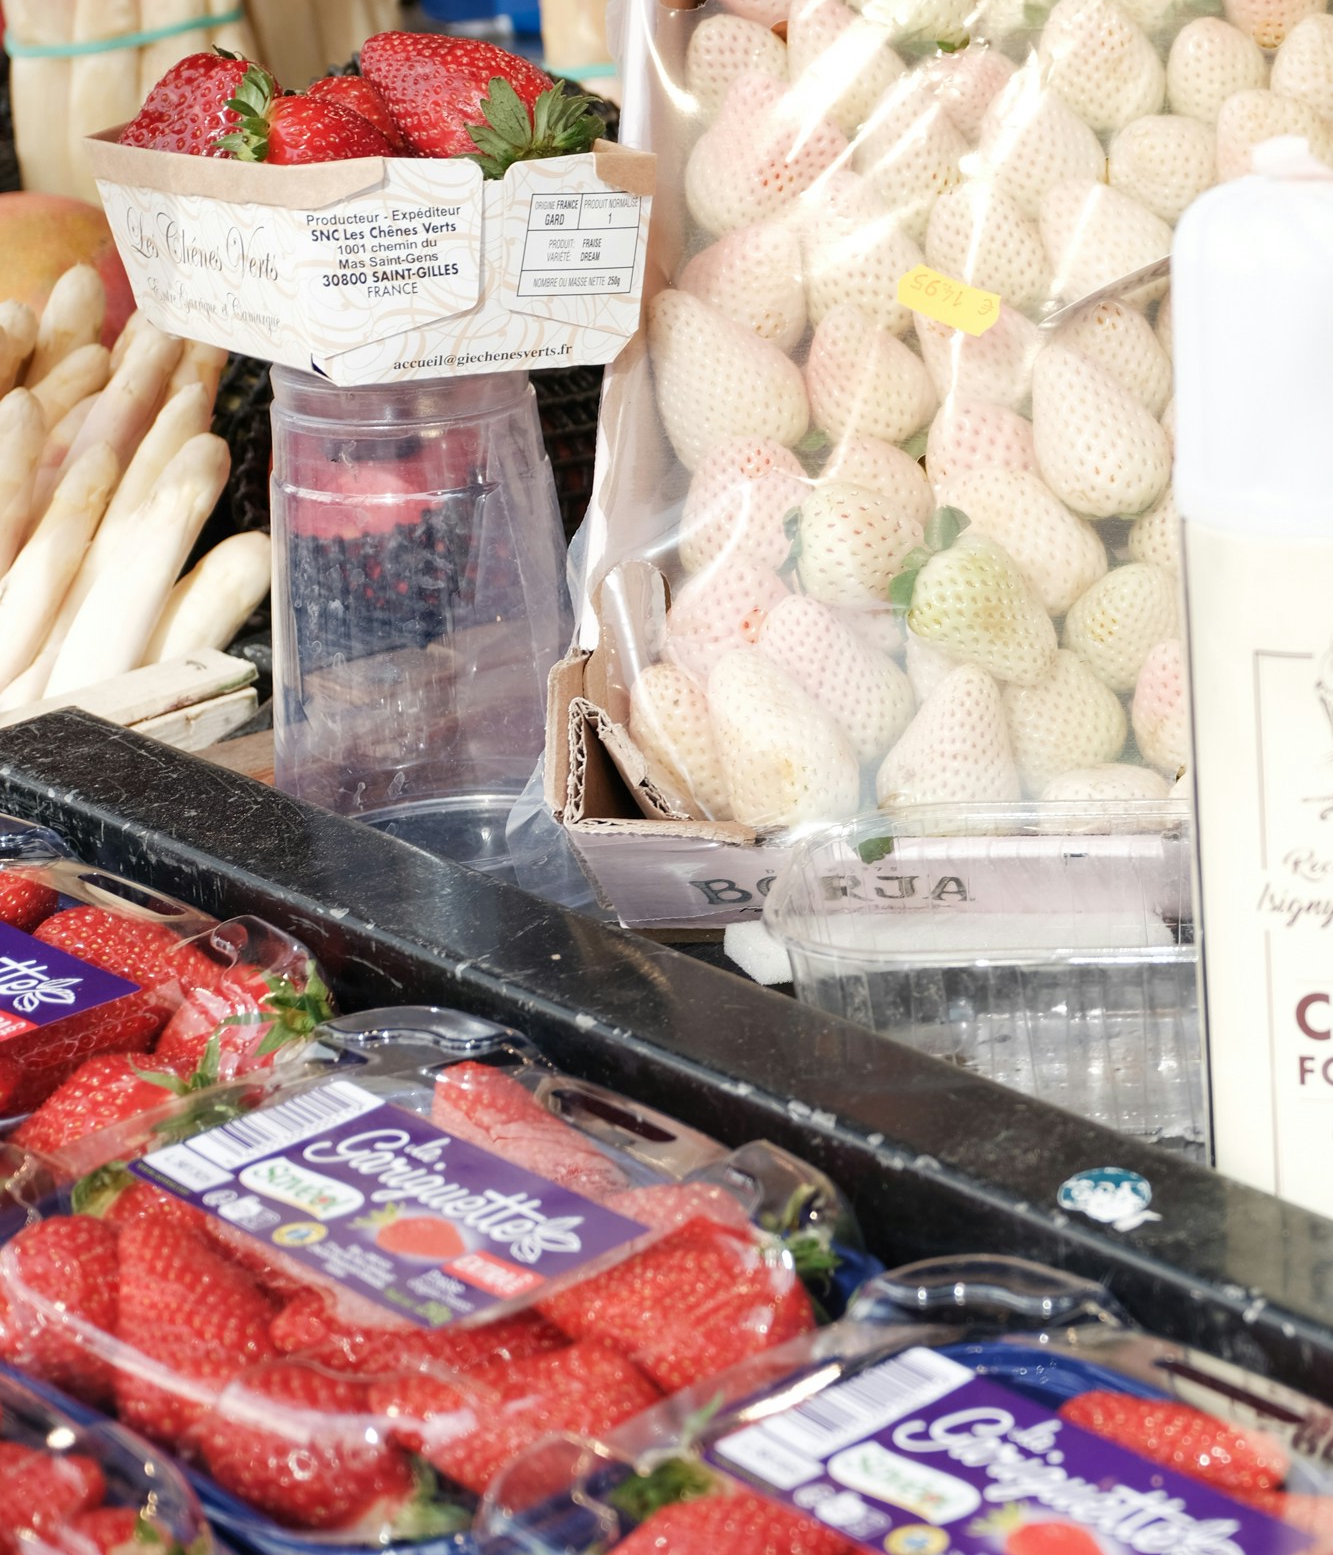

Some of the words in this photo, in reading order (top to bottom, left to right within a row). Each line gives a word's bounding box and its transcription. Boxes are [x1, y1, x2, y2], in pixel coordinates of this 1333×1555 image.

[556, 199, 578, 210] FRANCE
[584, 199, 607, 210] PRODUIT
[306, 213, 379, 226] Producteur
[392, 206, 461, 225] Expéditeur
[545, 213, 565, 226] GARD
[311, 229, 340, 242] SNC
[344, 228, 364, 240] Les
[370, 225, 418, 239] Chênes
[422, 222, 456, 234] Verts
[126, 206, 159, 259] Les
[156, 212, 223, 272] Chênes
[226, 226, 278, 281] Verts
[338, 244, 366, 255] 1001
[371, 240, 418, 253] chemin
[421, 238, 437, 248] du
[582, 238, 602, 248] FRAISE
[339, 259, 366, 270] Mas
[369, 252, 439, 267] Saint-Gens
[580, 251, 600, 262] DREAM
[322, 272, 368, 287] 30800
[372, 263, 459, 282] SAINT-GILLES
[533, 277, 558, 288] NOMBRE
[559, 277, 567, 287] OU
[568, 277, 586, 287] MASSE
[587, 276, 606, 287] NETTE
[607, 275, 621, 287] 250g
[367, 282, 418, 298] FRANCE
[393, 343, 573, 371] accueil@giechenesverts.fr
[302, 1129, 545, 1246] Gariguette
